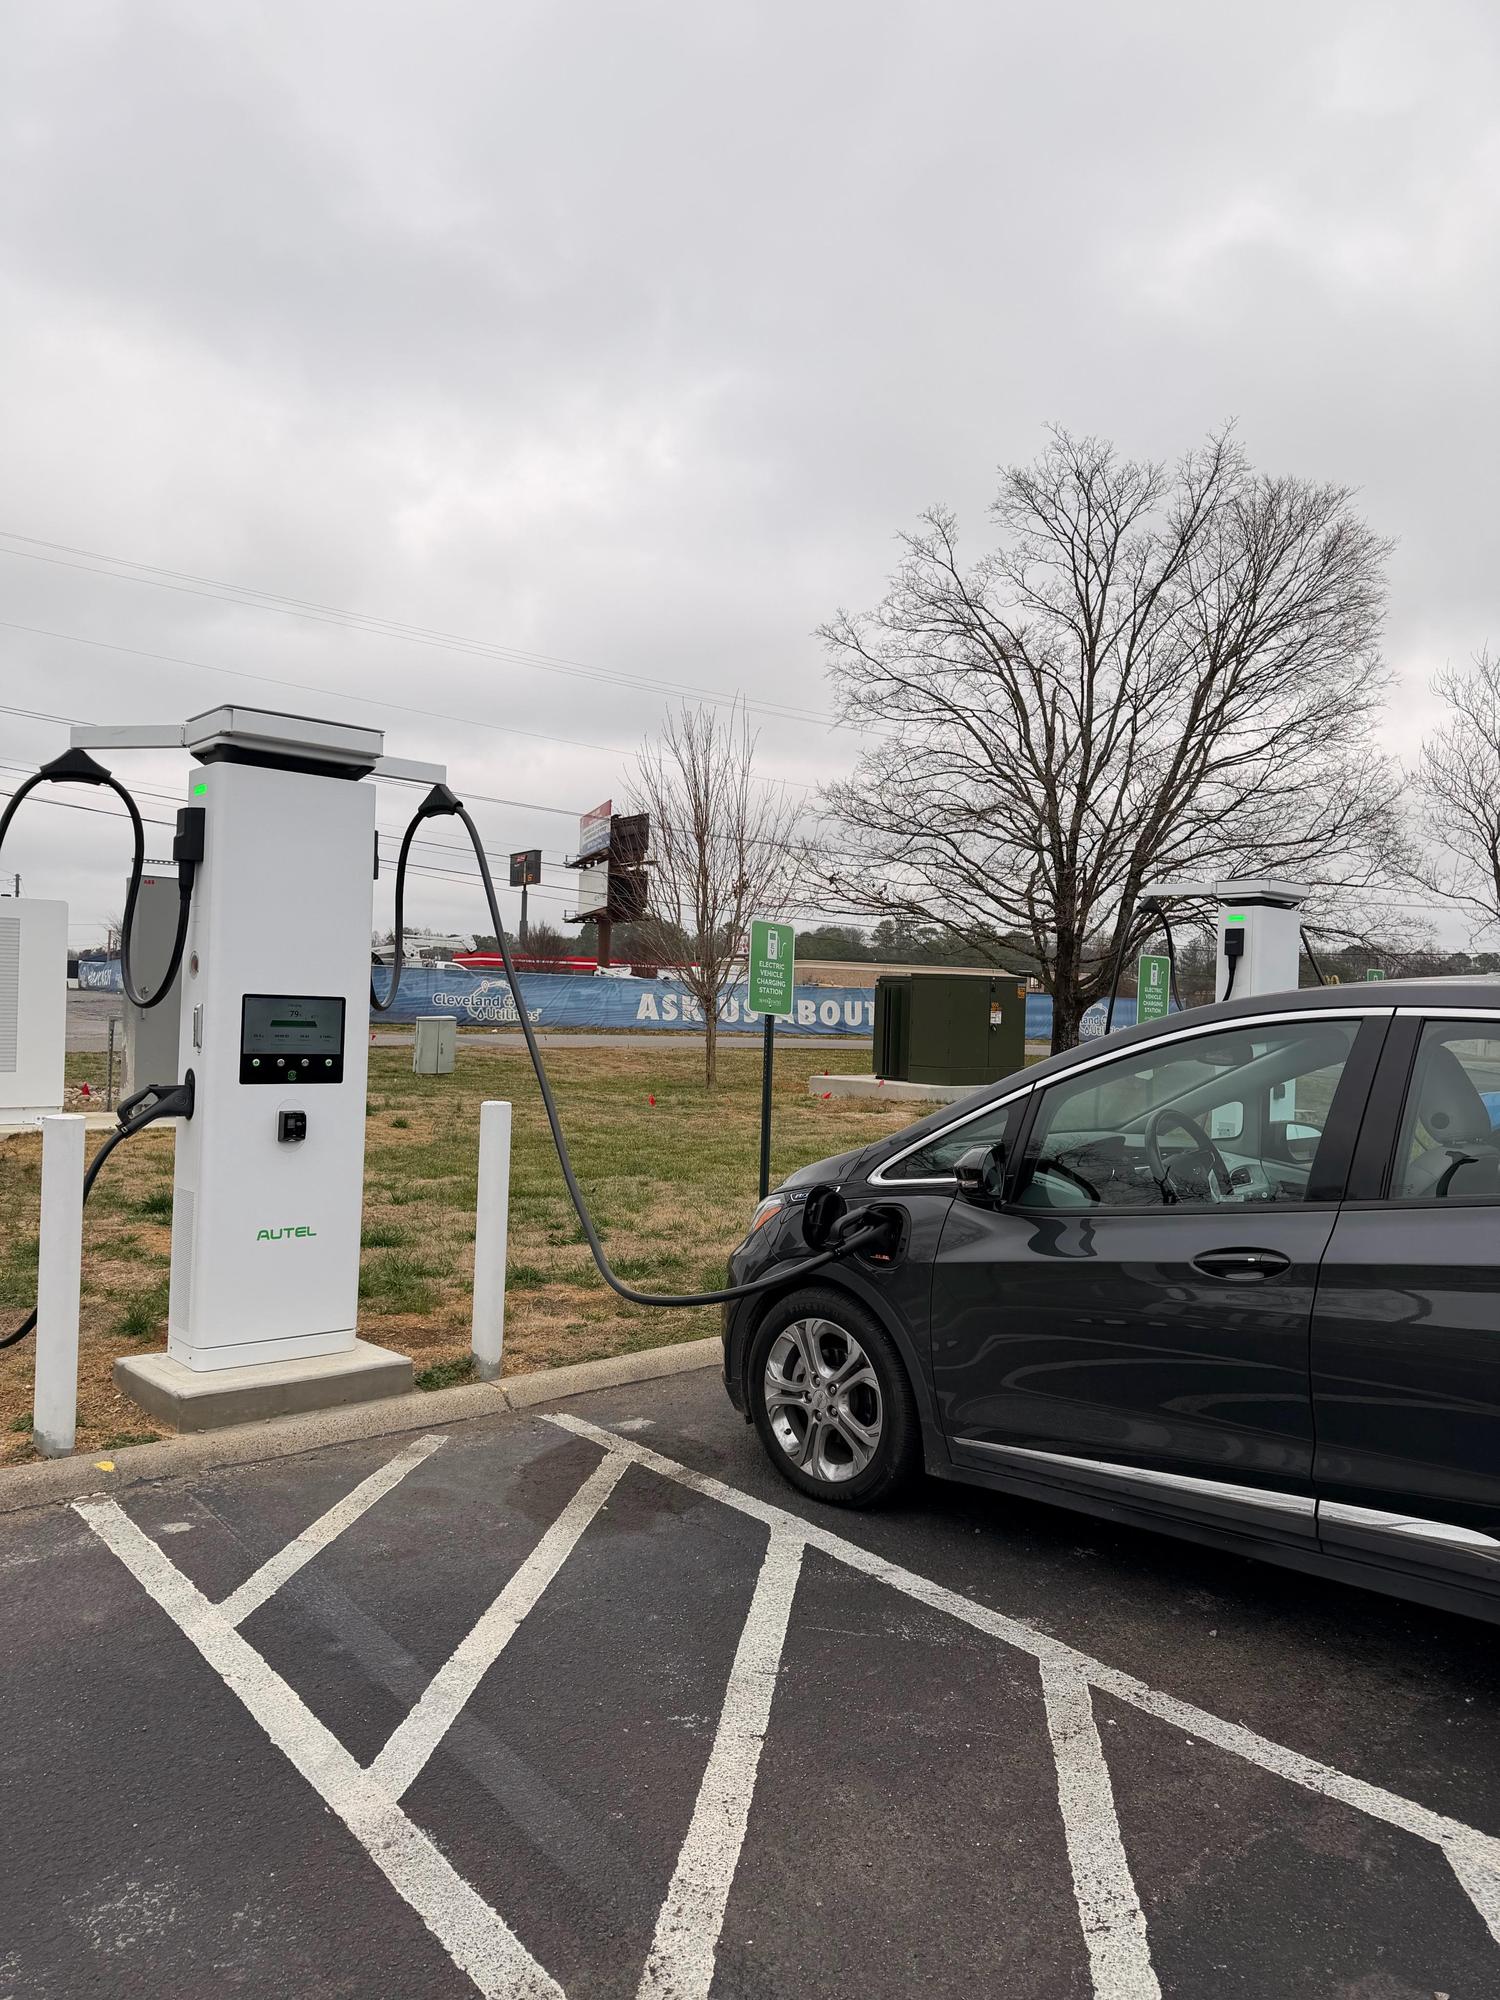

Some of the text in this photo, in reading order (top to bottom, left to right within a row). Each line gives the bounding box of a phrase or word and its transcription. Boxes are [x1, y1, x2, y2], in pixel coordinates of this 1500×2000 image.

[759, 960, 785, 970] ELECTRIC
[760, 969, 783, 979] VEHICLE
[757, 978, 786, 988] CHARGING
[759, 986, 783, 996] STATION
[433, 993, 501, 1007] Cleveland
[636, 993, 703, 1022] ASK
[486, 1007, 539, 1021] Utilites
[256, 1226, 317, 1241] AUTEL
